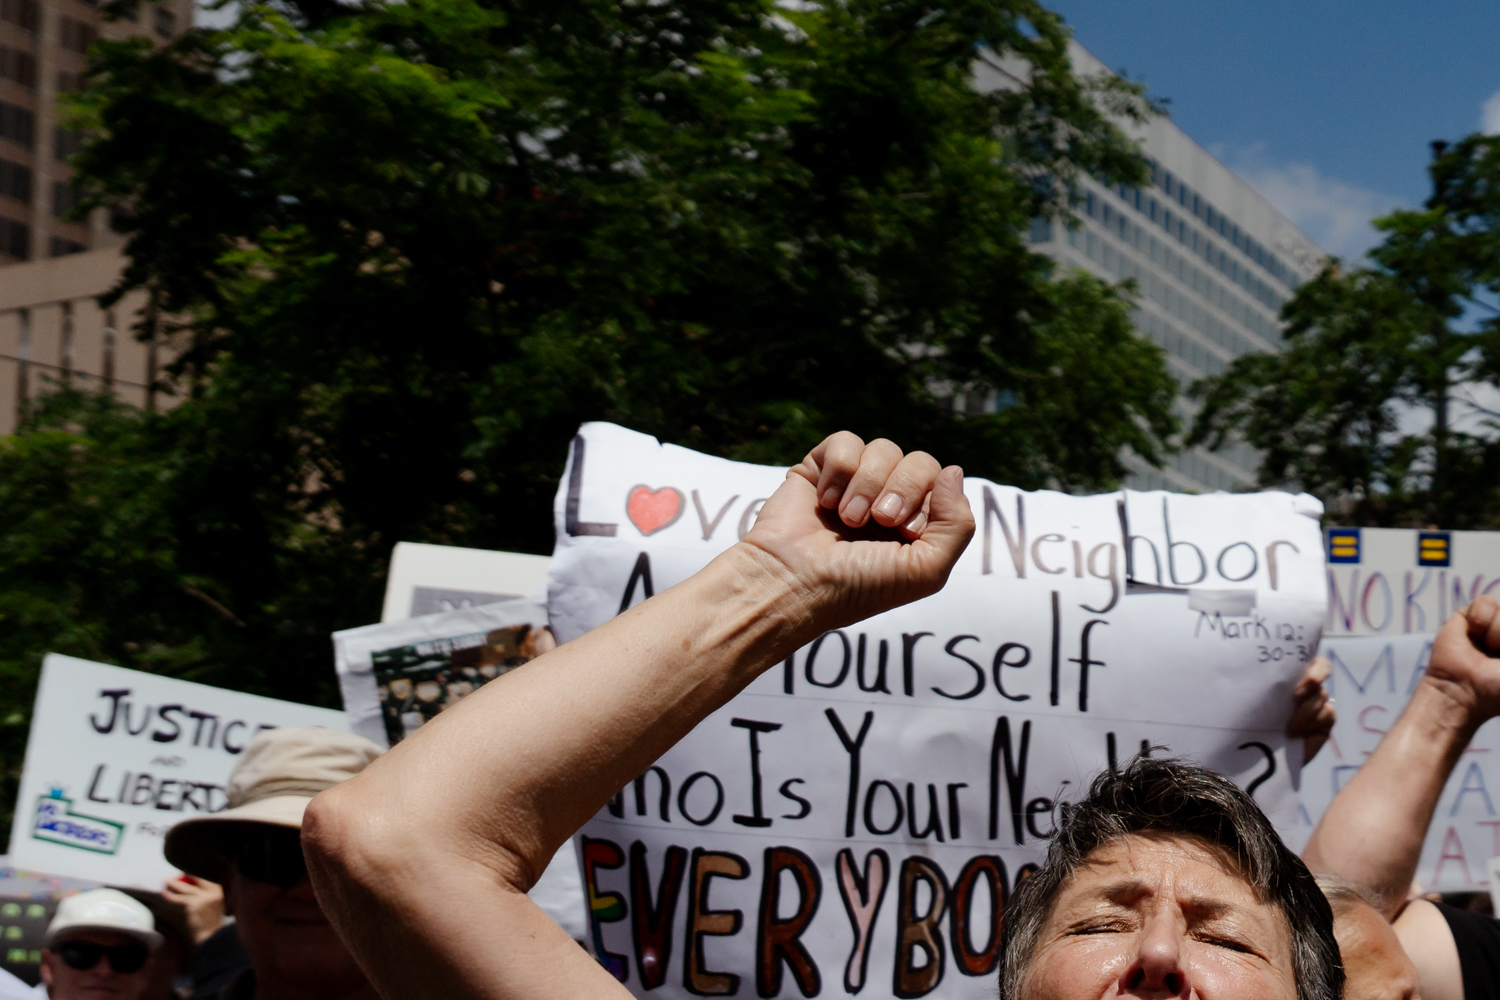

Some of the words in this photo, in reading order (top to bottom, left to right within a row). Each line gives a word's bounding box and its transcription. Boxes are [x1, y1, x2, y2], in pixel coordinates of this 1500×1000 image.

[981, 484, 1300, 614] Neighbor
[1194, 610, 1271, 640] Mark
[1327, 568, 1394, 633] NO
[88, 688, 273, 755] JUSTIC
[824, 708, 969, 844] Your
[581, 833, 1040, 1000] EVERYBO
